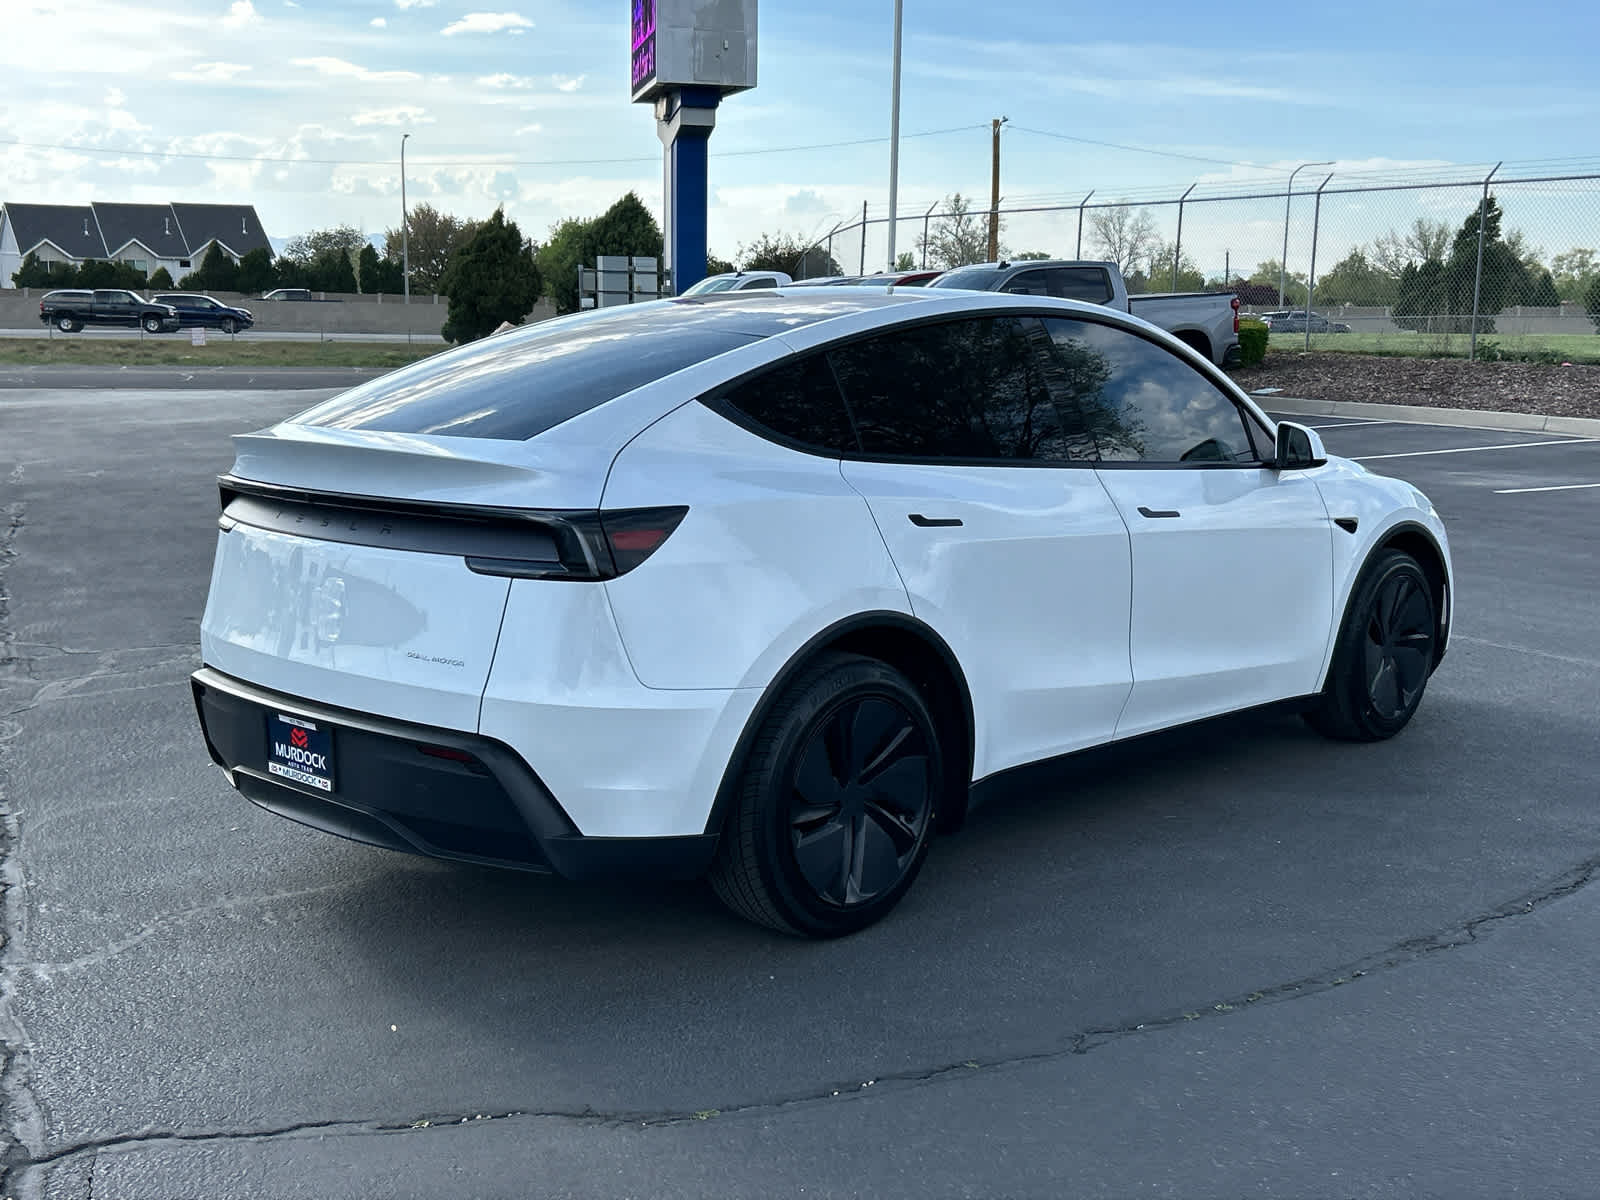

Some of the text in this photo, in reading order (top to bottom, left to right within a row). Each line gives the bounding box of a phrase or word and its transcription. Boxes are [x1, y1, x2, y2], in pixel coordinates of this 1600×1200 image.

[272, 511, 392, 534] TESLA
[275, 741, 326, 770] MURDOCK
[281, 767, 318, 785] MURDOCK
